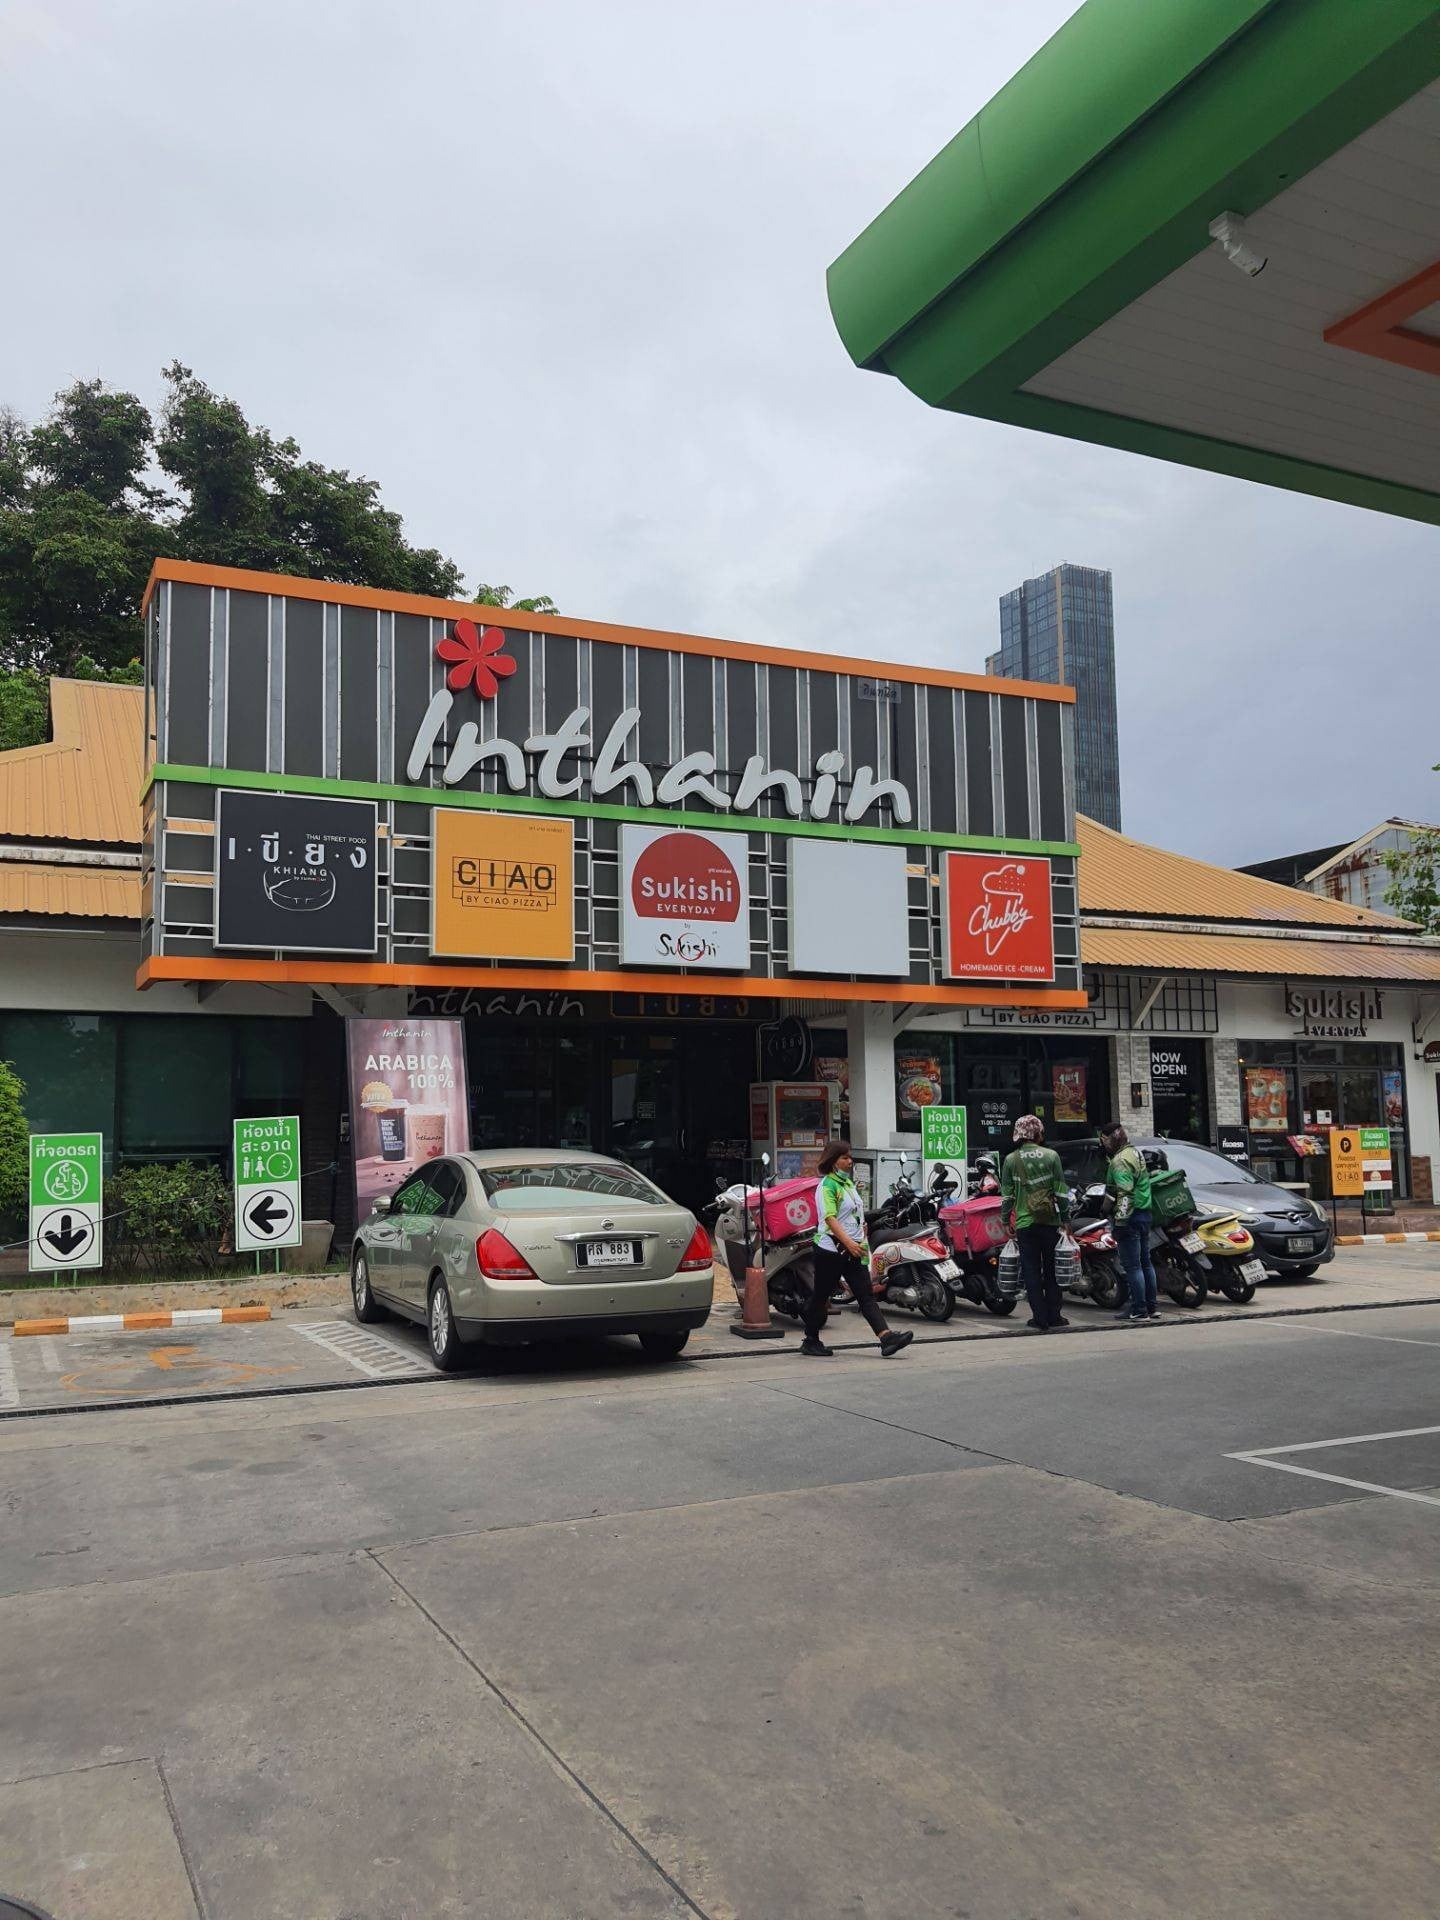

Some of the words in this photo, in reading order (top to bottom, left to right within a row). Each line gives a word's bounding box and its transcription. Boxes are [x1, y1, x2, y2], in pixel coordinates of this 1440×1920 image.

[306, 833, 321, 841] THAI
[323, 835, 346, 843] STREET
[273, 866, 328, 877] KHIANG
[457, 860, 552, 890] CIAO
[641, 876, 732, 902] Sukishi
[466, 895, 480, 903] BY
[483, 896, 509, 905] CIAO
[513, 898, 542, 907] PIZZA
[657, 903, 716, 915] EVERYDAY
[968, 898, 1034, 936] Chubby
[960, 963, 1002, 972] HOMEMADE
[1005, 964, 1016, 972] ICE
[1287, 989, 1384, 1019] Sukishi
[1000, 1012, 1015, 1023] BY
[1019, 1014, 1050, 1025] CIAO
[1055, 1015, 1090, 1026] PIZZA
[1305, 1024, 1368, 1037] EVERYDAY
[364, 1054, 454, 1071] ARABICA
[1152, 1052, 1181, 1063] NOW
[1152, 1064, 1188, 1075] OPEN!
[408, 1074, 455, 1089] 100%
[928, 1107, 961, 1122] ห้องน้ำ
[243, 1119, 290, 1138] ห้องน้ำ
[928, 1124, 962, 1134] สะอาด
[35, 1139, 96, 1158] ที่จอดรถ
[241, 1139, 291, 1153] สะอาด
[1166, 1190, 1188, 1209] Grab
[610, 1243, 630, 1255] 883
